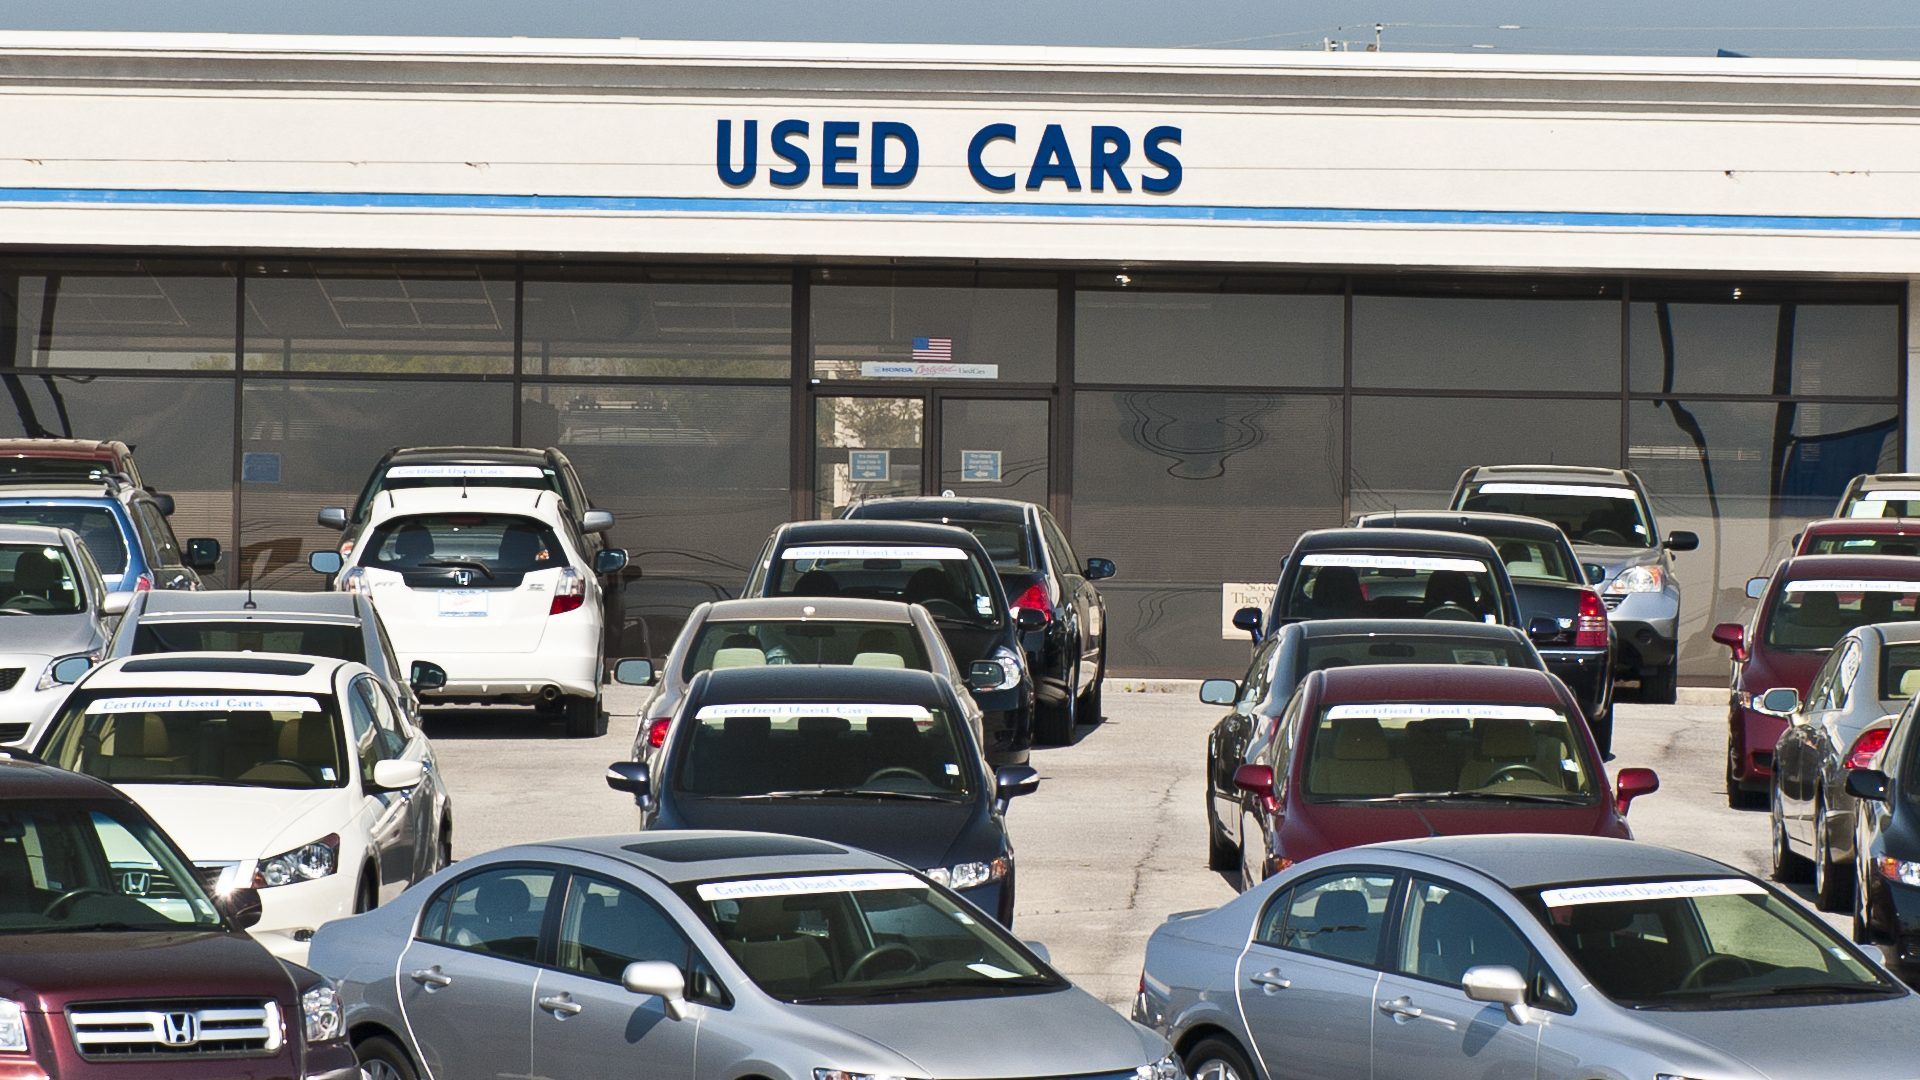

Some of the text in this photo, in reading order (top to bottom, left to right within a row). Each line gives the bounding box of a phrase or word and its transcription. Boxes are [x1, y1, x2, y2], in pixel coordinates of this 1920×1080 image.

[717, 119, 1183, 193] USED CARS
[103, 699, 173, 710] Certified
[178, 698, 220, 708] Used
[226, 698, 264, 708] Cars
[714, 706, 873, 714] Certified Used Cars
[1344, 707, 1503, 716] Certified Used Cars
[714, 877, 878, 895] Certified Used Cars
[1558, 884, 1718, 901] Certified Used Cars
